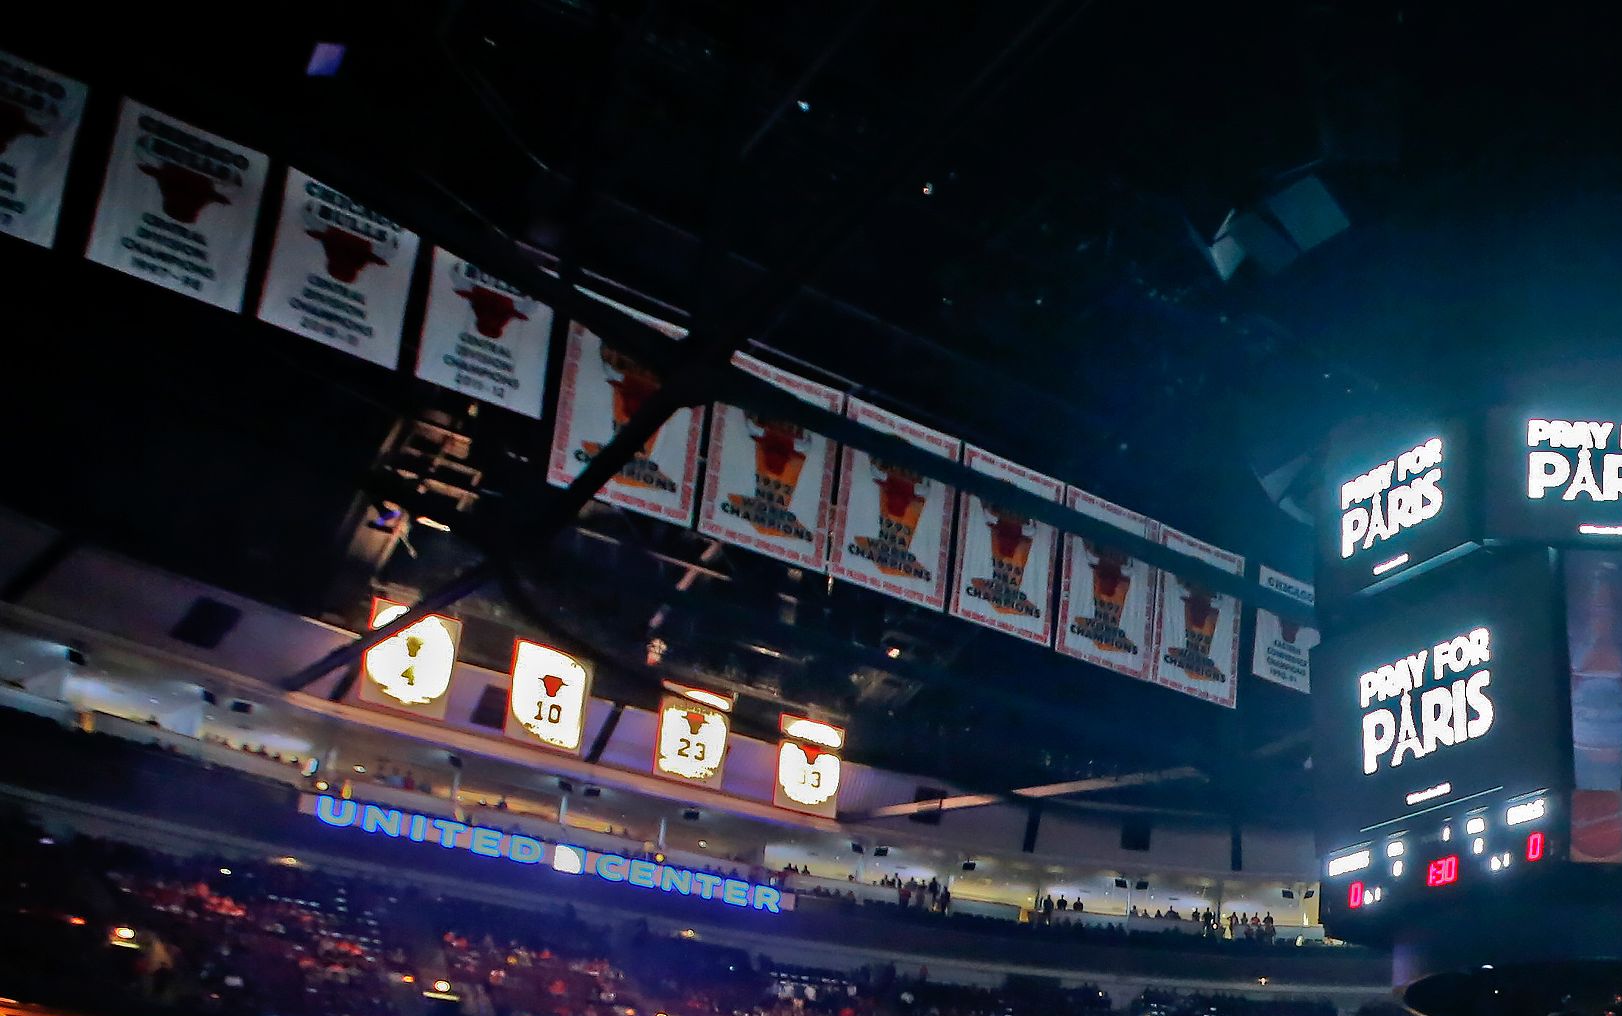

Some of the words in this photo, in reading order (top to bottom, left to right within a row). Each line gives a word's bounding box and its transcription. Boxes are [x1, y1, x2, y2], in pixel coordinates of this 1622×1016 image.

[1527, 419, 1614, 450] PRAY
[1398, 438, 1442, 481] FOR
[721, 503, 814, 542] CHAMPIONS
[1342, 468, 1443, 558] PARIS
[848, 544, 931, 581] CHAMPIONS
[966, 586, 1041, 619] CHAMPIONS
[1070, 624, 1138, 655] CHAMPIONS
[1164, 654, 1226, 683] CHAMPIONS
[1360, 650, 1428, 708] PRAY
[1434, 628, 1490, 680] FOR
[534, 700, 562, 724] 10
[1363, 669, 1494, 774] PARIS
[677, 738, 706, 761] 23
[316, 795, 545, 865] UNITED
[594, 852, 782, 914] CENTER
[1527, 831, 1545, 862] 0
[1349, 881, 1363, 908] 0
